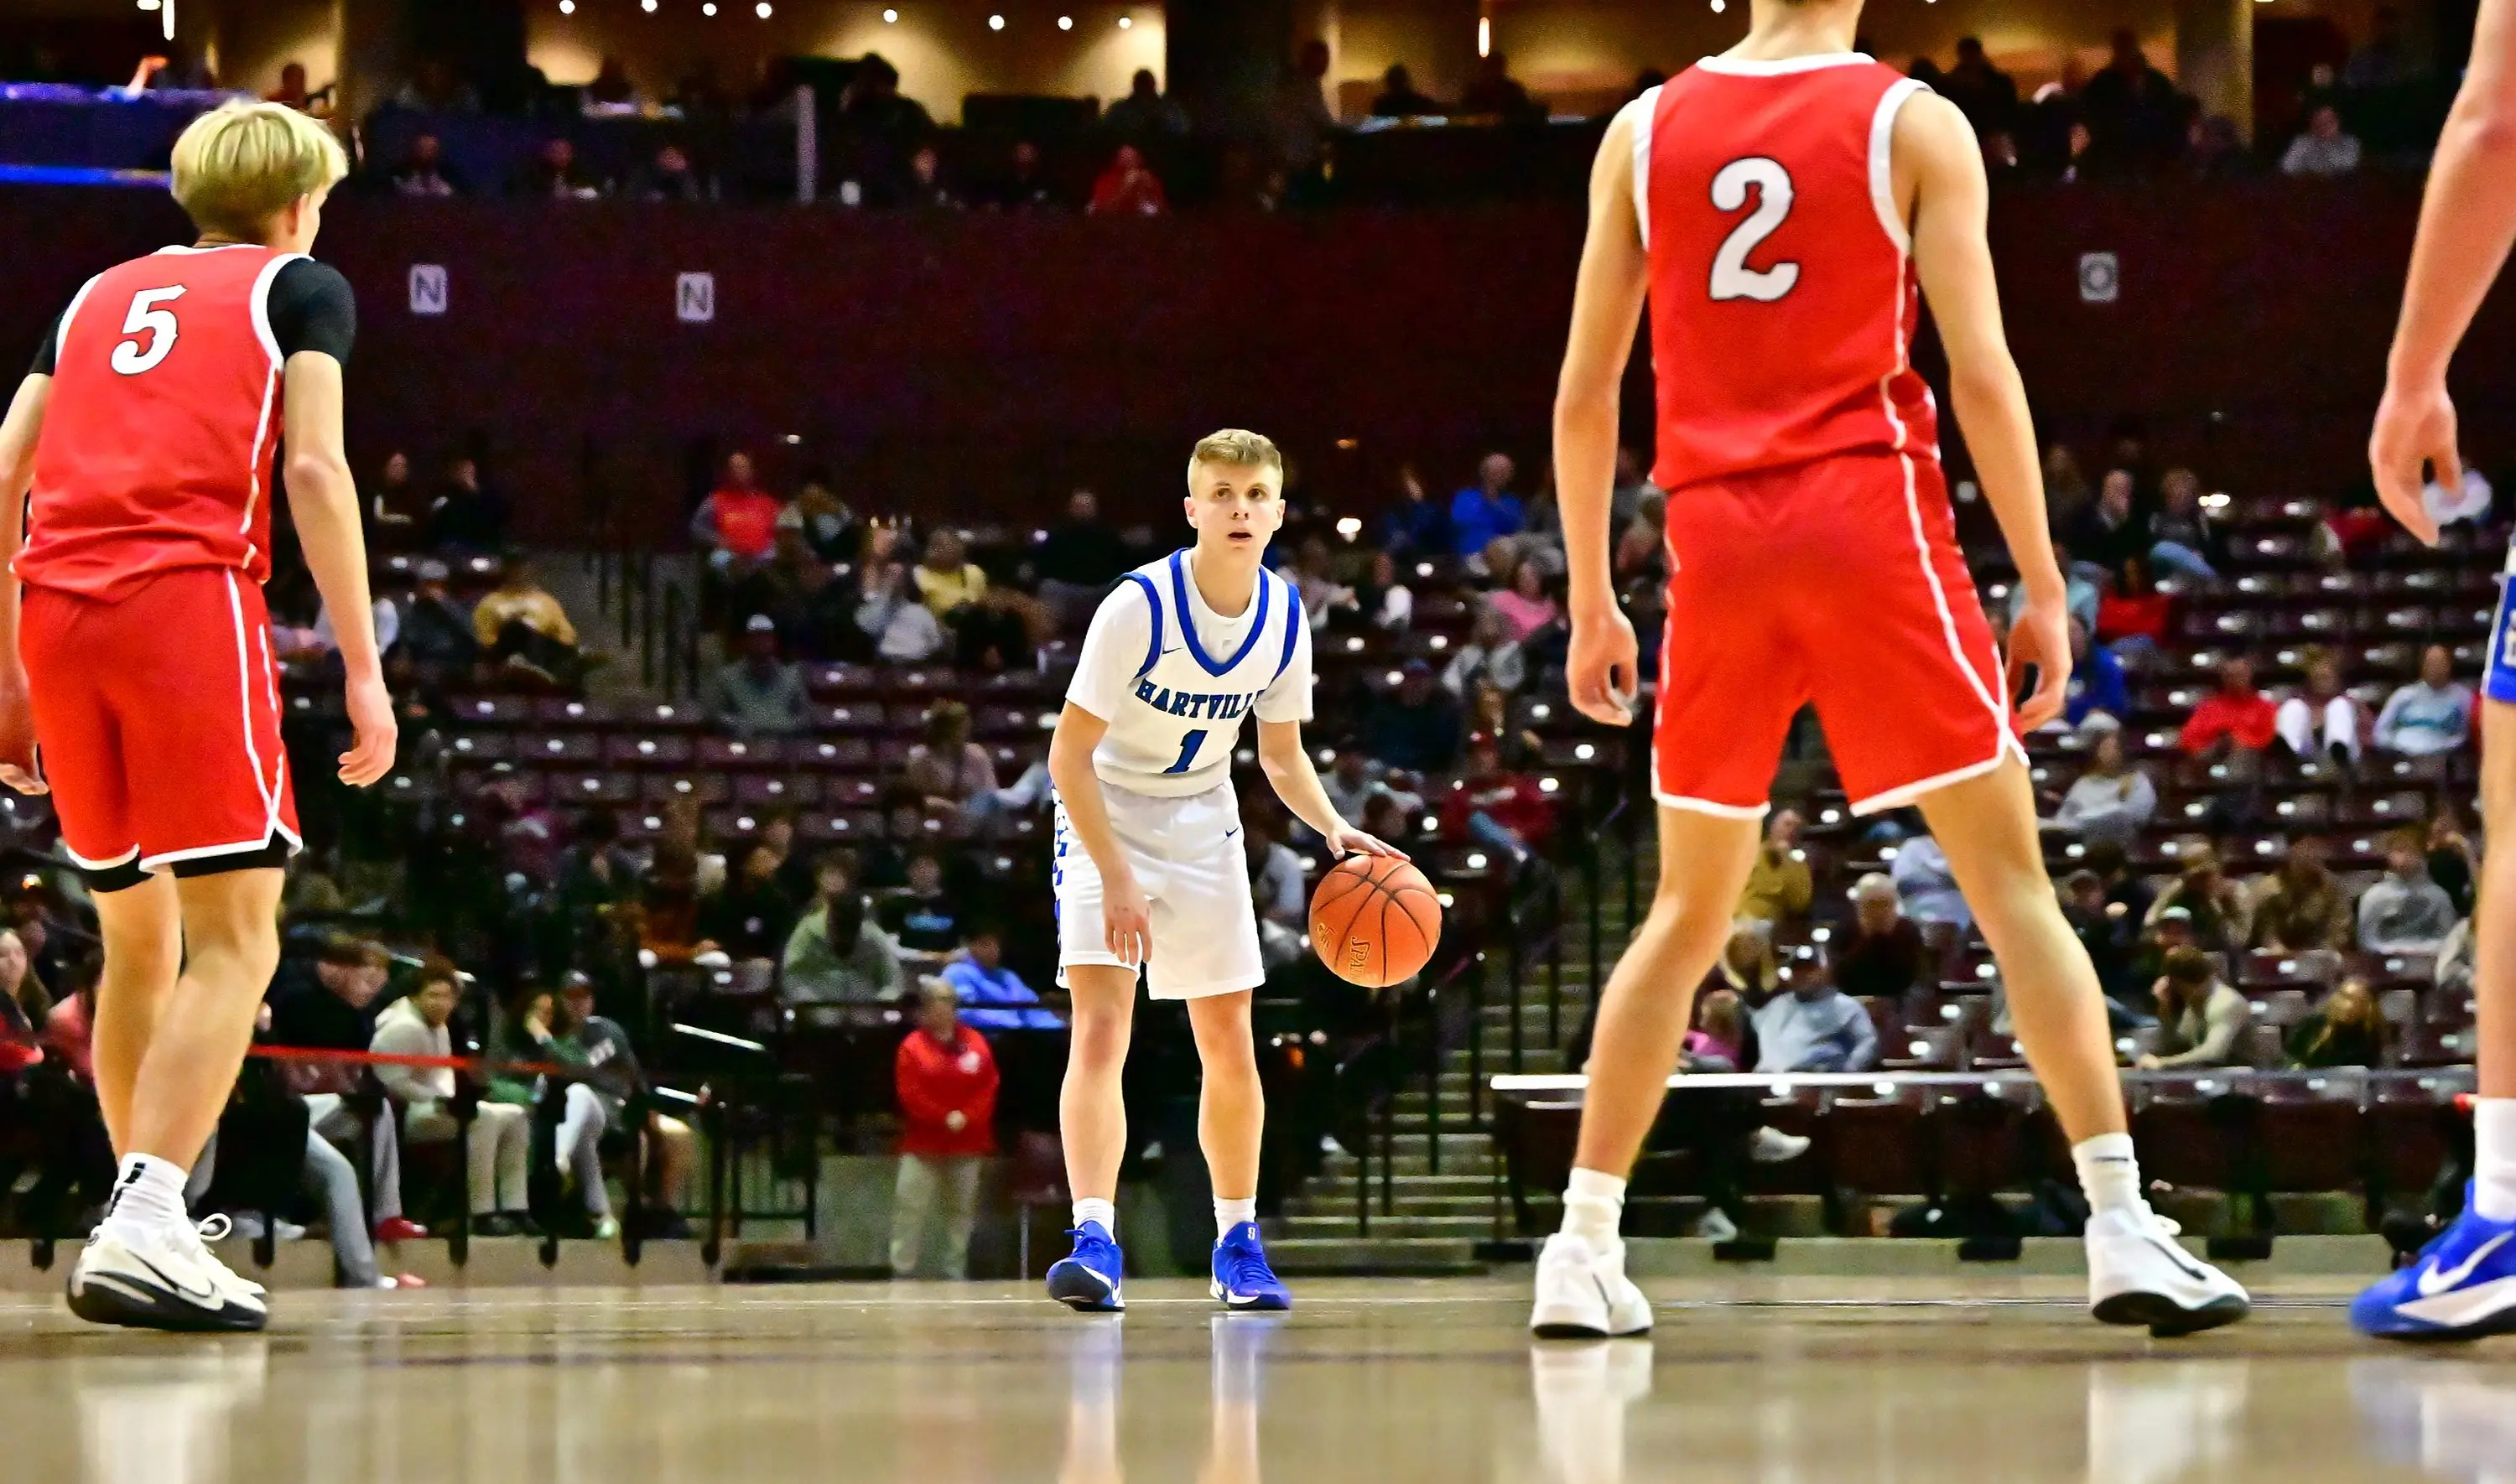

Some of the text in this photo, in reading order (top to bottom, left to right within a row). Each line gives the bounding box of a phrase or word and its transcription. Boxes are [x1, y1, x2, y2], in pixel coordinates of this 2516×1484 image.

[1708, 155, 1800, 302] 2
[415, 272, 440, 304] N
[683, 281, 708, 313] N
[110, 283, 188, 376] 5
[1135, 678, 1266, 719] HARTVILL
[1162, 729, 1209, 774] 1
